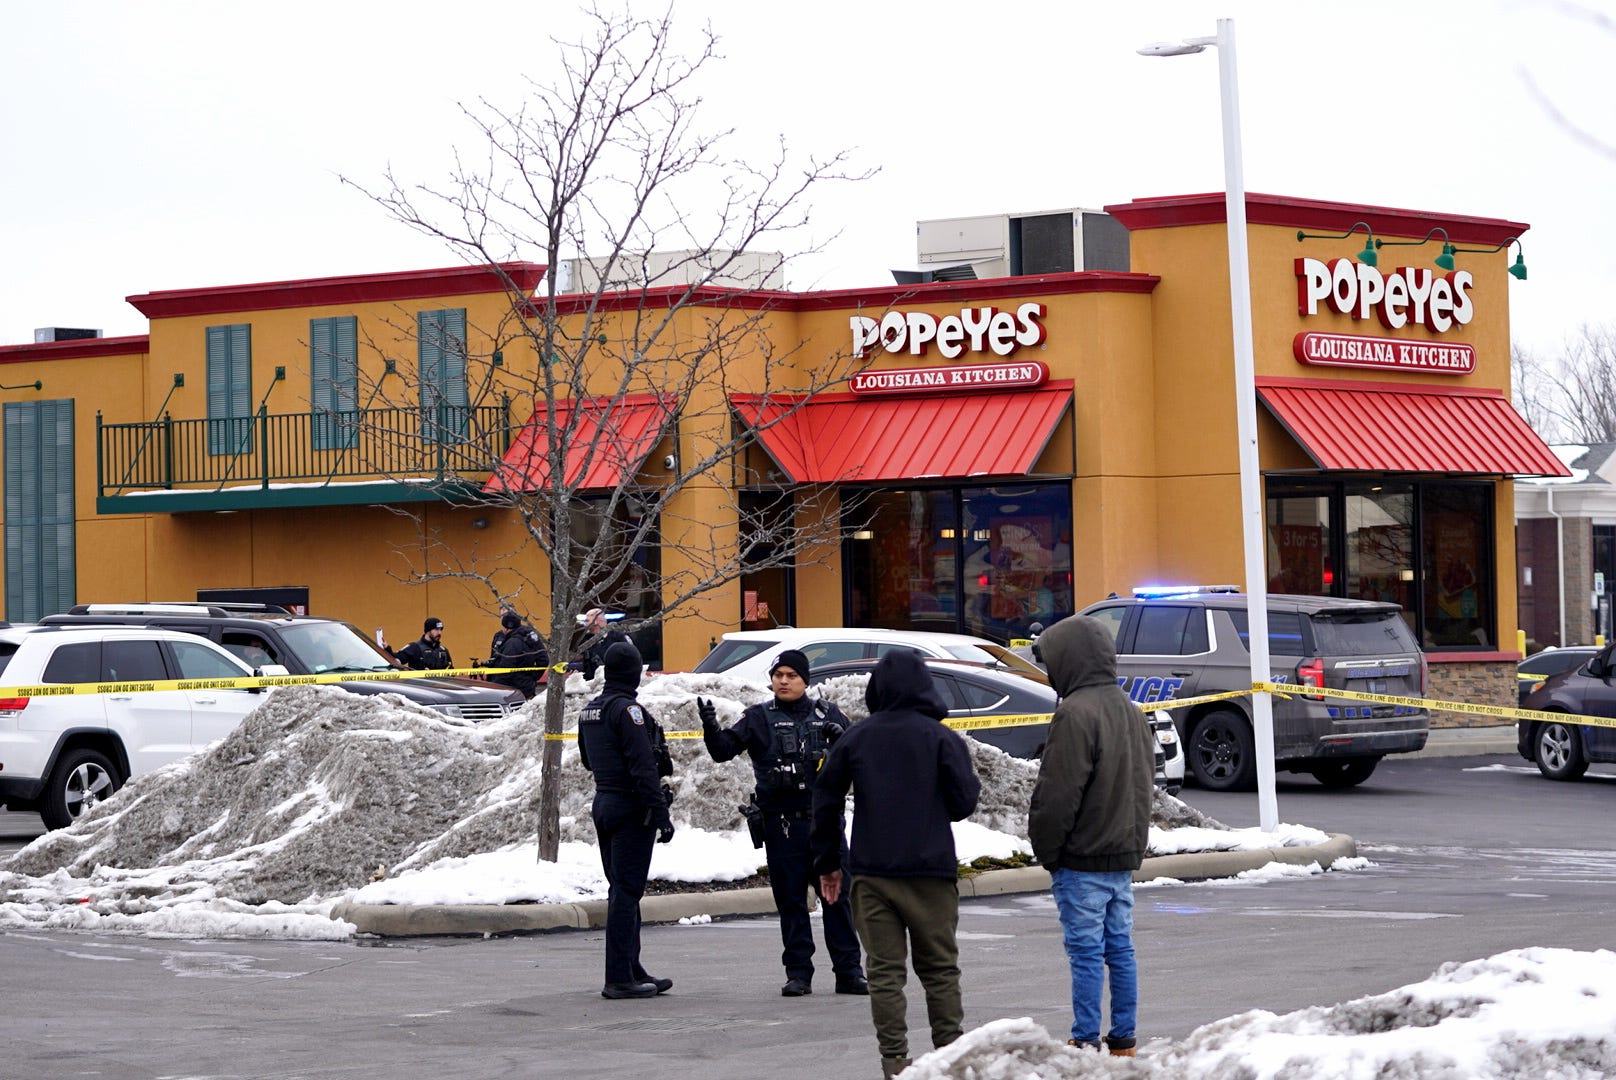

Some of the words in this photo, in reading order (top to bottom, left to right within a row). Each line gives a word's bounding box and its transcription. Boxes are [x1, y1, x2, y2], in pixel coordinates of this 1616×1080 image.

[1310, 338, 1395, 363] LOUISIANA
[1399, 345, 1471, 368] KITCHEN
[856, 372, 946, 389] LOUISIANA
[951, 366, 1033, 384] KITCHEN
[1283, 531, 1290, 545] 3
[1292, 531, 1308, 547] for
[97, 685, 112, 693] CROSS
[122, 684, 129, 692] DO
[129, 684, 139, 692] LINE
[139, 683, 154, 692] POLICE
[178, 683, 192, 691] CROSS
[193, 682, 201, 690] NOT
[210, 681, 219, 689] LINE
[1276, 684, 1293, 692] POLICE
[17, 688, 32, 697] CROSS
[33, 688, 41, 696] NOT
[42, 687, 48, 696] DO
[49, 687, 59, 696] LINE
[59, 686, 75, 695] POLICE
[1116, 676, 1185, 704] ICE
[1355, 693, 1373, 701] POLICE
[1407, 698, 1423, 706] CROSS
[1435, 702, 1453, 710] POLICE
[1453, 703, 1466, 711] LINE
[1487, 707, 1503, 715] CROSS
[580, 709, 602, 721] POLICE
[1515, 710, 1532, 718] POLICE
[1555, 713, 1565, 721] NOT
[1594, 719, 1611, 727] POLICE
